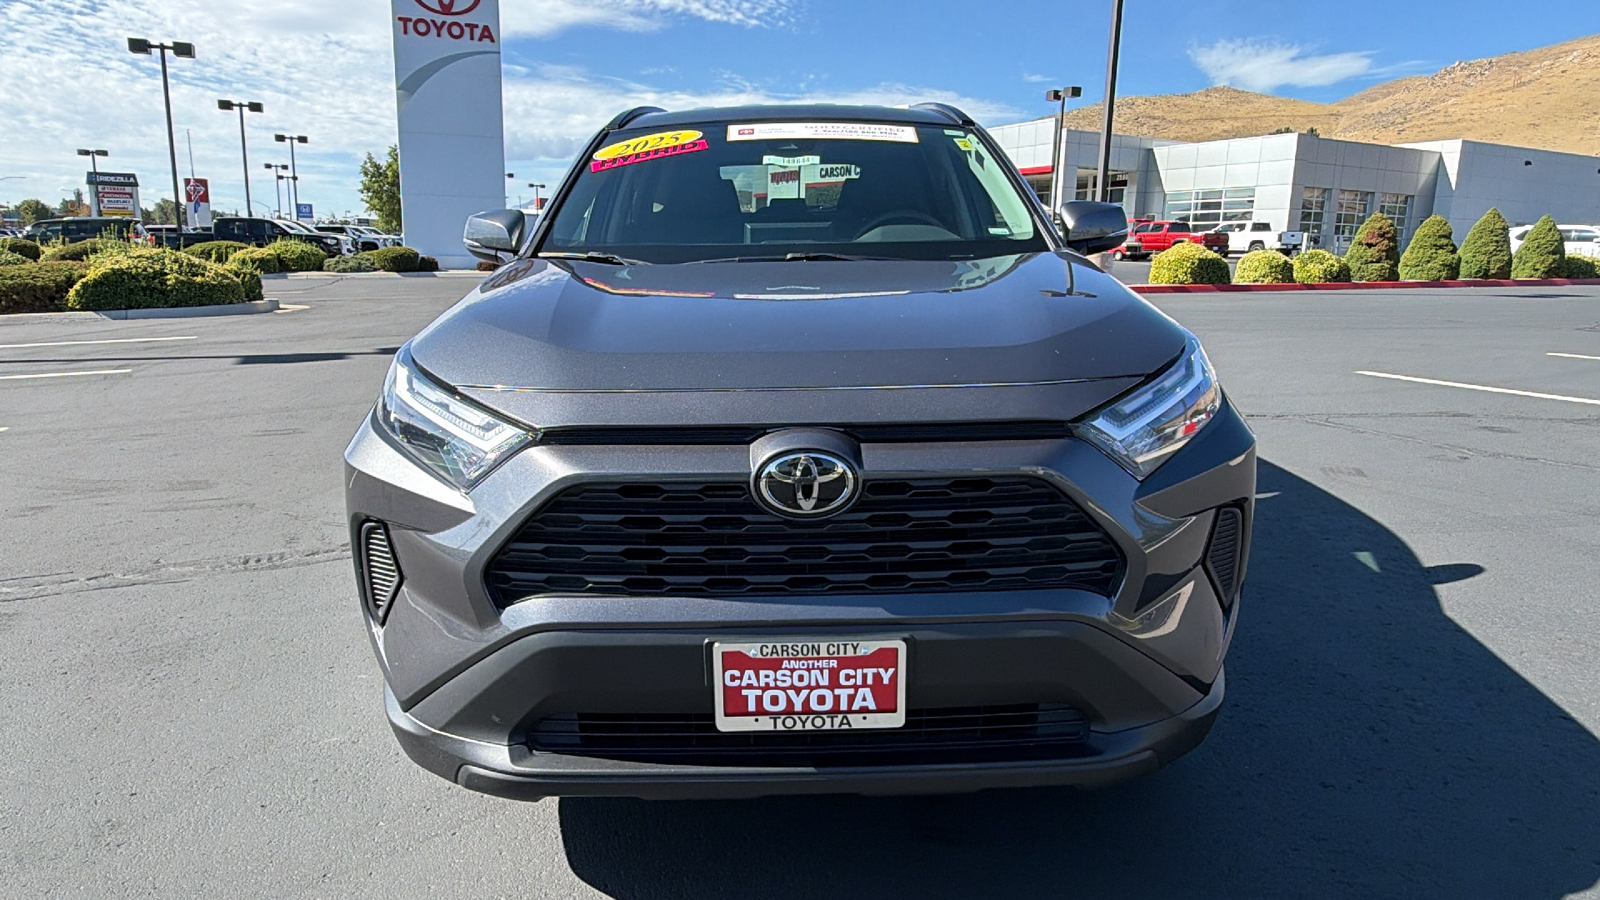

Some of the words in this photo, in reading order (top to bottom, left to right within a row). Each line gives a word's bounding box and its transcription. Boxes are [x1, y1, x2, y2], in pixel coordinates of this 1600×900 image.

[397, 16, 496, 43] TOYOTA
[615, 132, 683, 157] 2025
[600, 141, 699, 168] HYBRID
[820, 165, 851, 179] CARSON
[759, 644, 821, 657] CARSON
[826, 643, 860, 656] CITY
[781, 659, 838, 669] ANOTHER
[724, 669, 829, 687] CARSON
[839, 668, 896, 686] CITY
[741, 687, 877, 712] TOYOTA
[768, 715, 853, 729] TOYOTA
